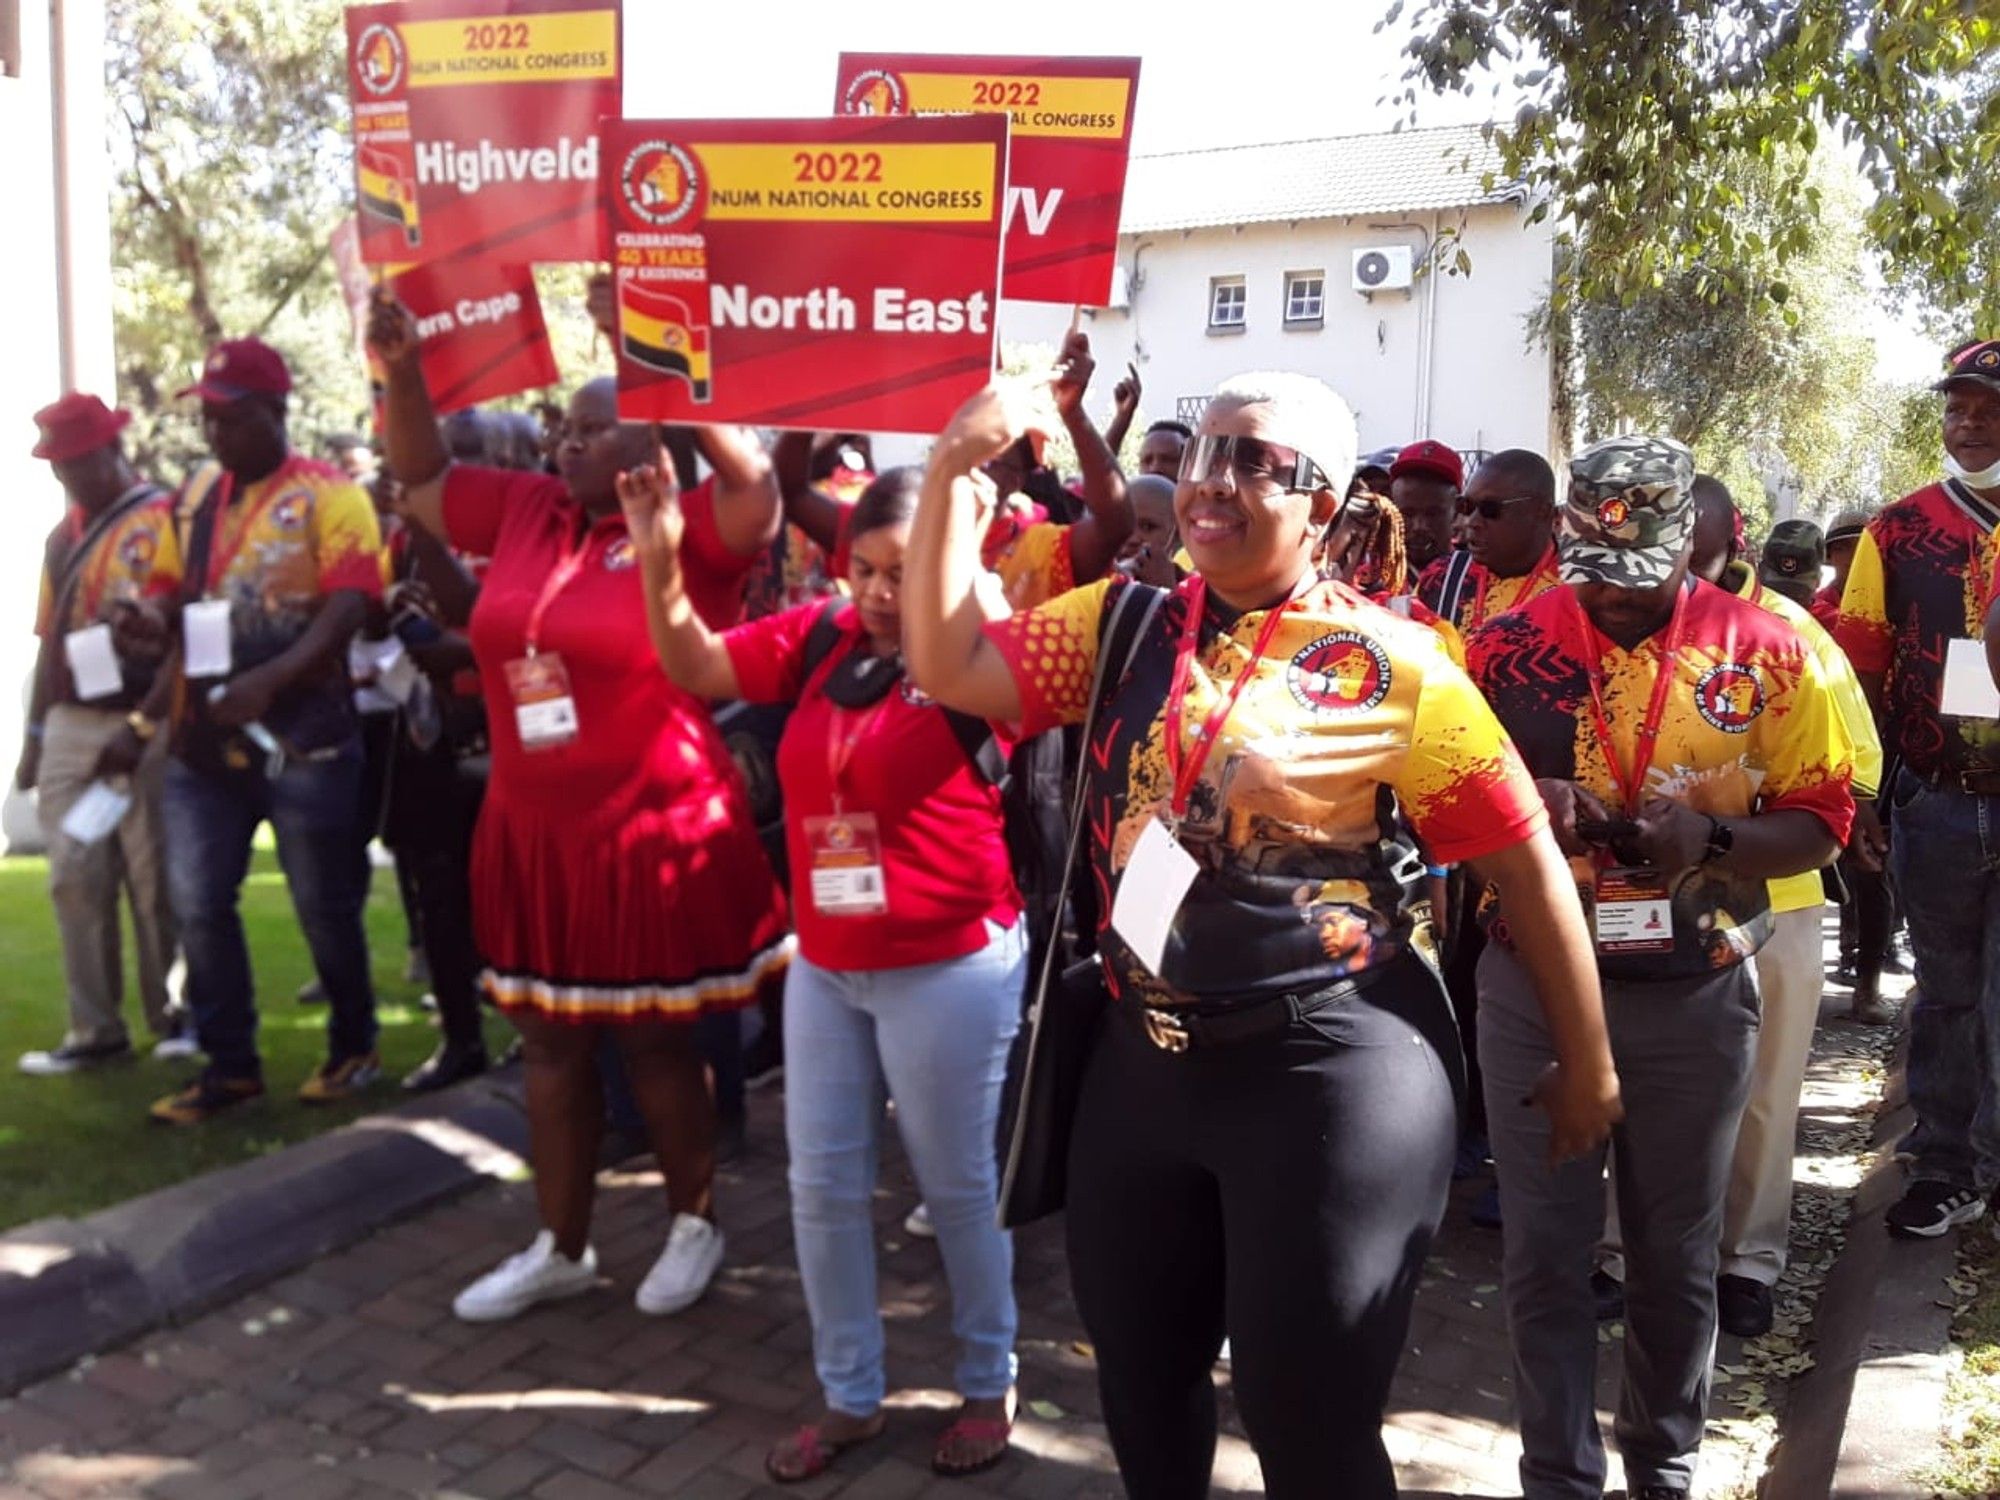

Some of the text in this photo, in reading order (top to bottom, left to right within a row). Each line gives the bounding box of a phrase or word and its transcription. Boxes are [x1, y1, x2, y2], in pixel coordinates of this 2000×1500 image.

[464, 23, 530, 51] 2022
[447, 57, 519, 72] NATIONAL
[525, 53, 606, 69] CONGRESS
[973, 82, 1041, 106] 2022
[1033, 113, 1115, 128] CONGRESS
[415, 136, 599, 194] Highveld
[794, 153, 882, 183] 2022
[712, 191, 982, 209] NUM NATIONAL CONGRESS
[644, 249, 705, 266] YEARS
[455, 291, 522, 325] Cape
[709, 285, 988, 334] North East
[1299, 632, 1391, 681] NATIONAL UNION
